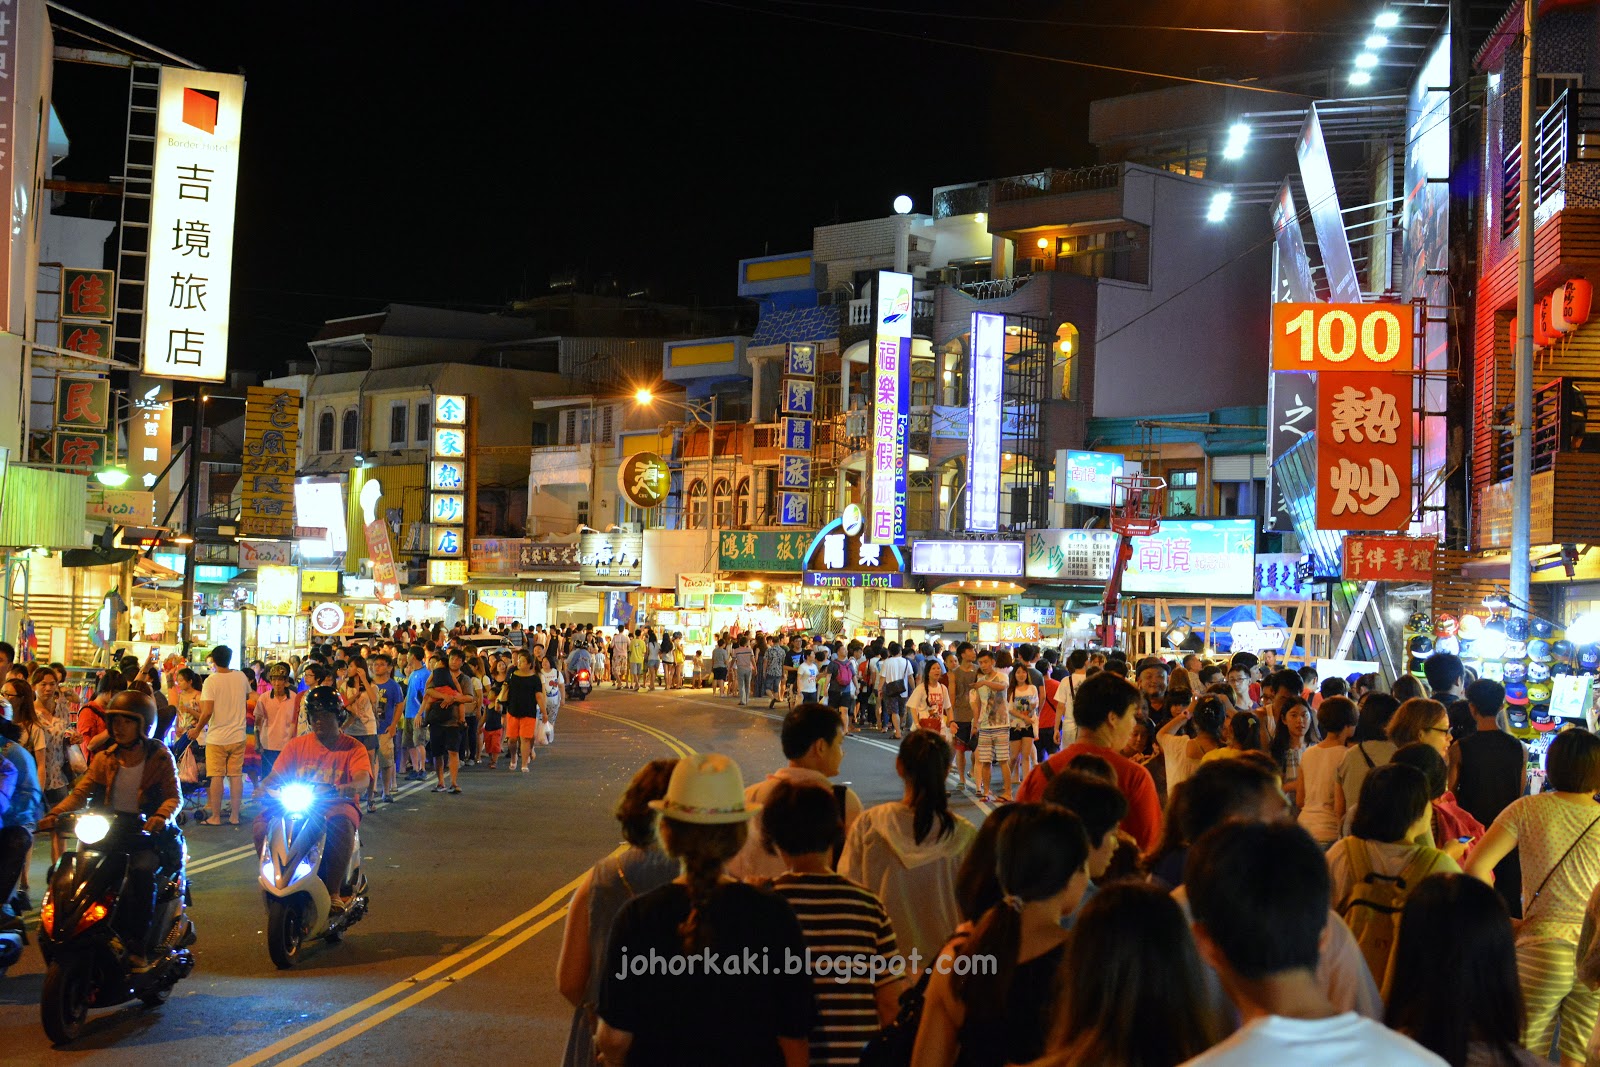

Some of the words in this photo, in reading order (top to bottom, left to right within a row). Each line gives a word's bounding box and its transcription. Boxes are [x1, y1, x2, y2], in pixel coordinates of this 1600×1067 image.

[168, 137, 198, 149] Border
[166, 163, 215, 367] 吉境旅店
[1285, 308, 1401, 363] 100
[61, 274, 107, 476] 佳佳民宿
[785, 346, 813, 522] 鴻賓渡假旅館
[873, 340, 897, 540] 福樂渡假旅店
[895, 412, 908, 482] Formost
[1329, 385, 1402, 516] 熱炒
[436, 397, 461, 554] 余家熱炒店
[894, 491, 906, 540] Hotel
[721, 532, 759, 560] 鴻賓
[1028, 532, 1065, 574] 珍珍
[1138, 538, 1191, 571] 南境
[1366, 546, 1432, 572] 伴手禮
[813, 572, 856, 587] Formost
[861, 573, 892, 588] Hotel
[1003, 625, 1037, 640] 地瓜球
